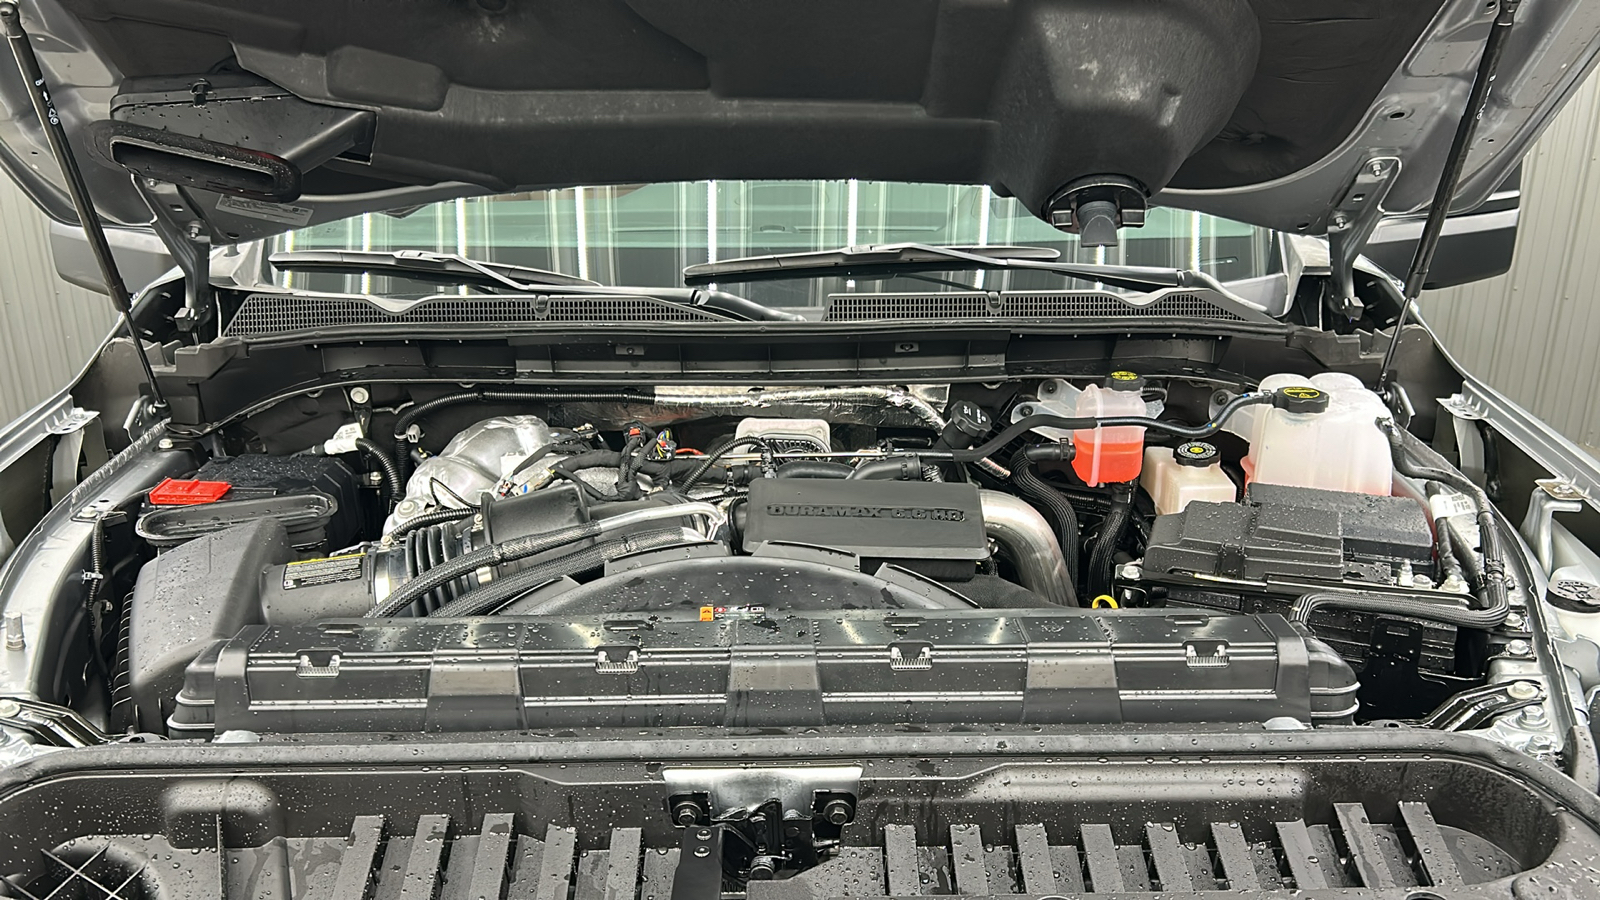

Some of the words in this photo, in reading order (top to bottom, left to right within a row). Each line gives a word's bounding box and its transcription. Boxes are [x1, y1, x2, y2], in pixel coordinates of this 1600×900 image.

[766, 504, 881, 518] DURAMAX
[890, 507, 927, 520] 6.6
[930, 508, 965, 522] HD
